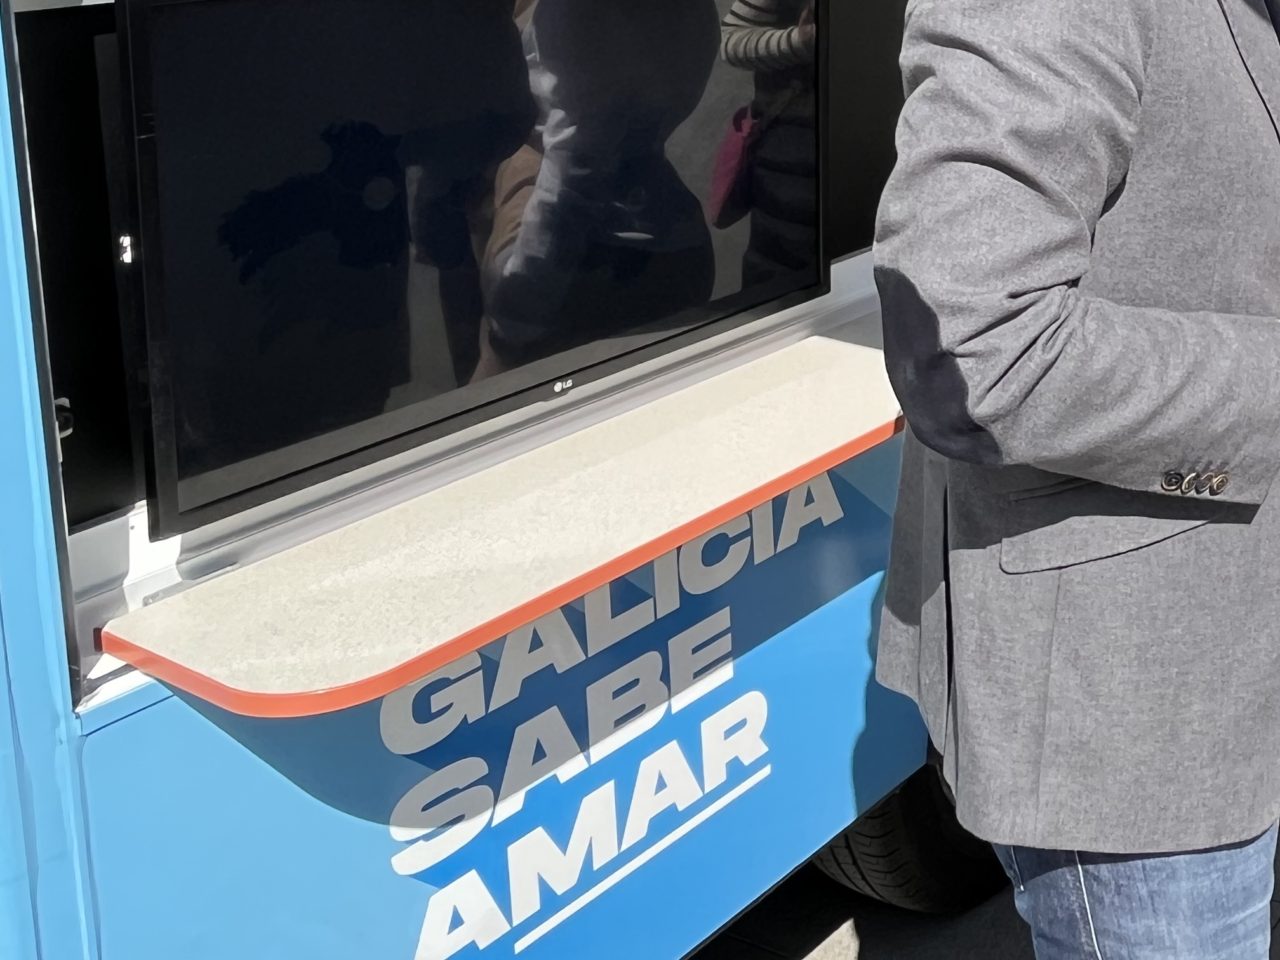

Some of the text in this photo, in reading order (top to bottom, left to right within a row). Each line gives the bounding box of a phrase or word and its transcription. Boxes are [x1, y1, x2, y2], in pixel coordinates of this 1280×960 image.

[562, 379, 573, 389] LG
[379, 469, 845, 755] GALICIA
[389, 606, 735, 876] SABE
[414, 690, 769, 960] AMAR
